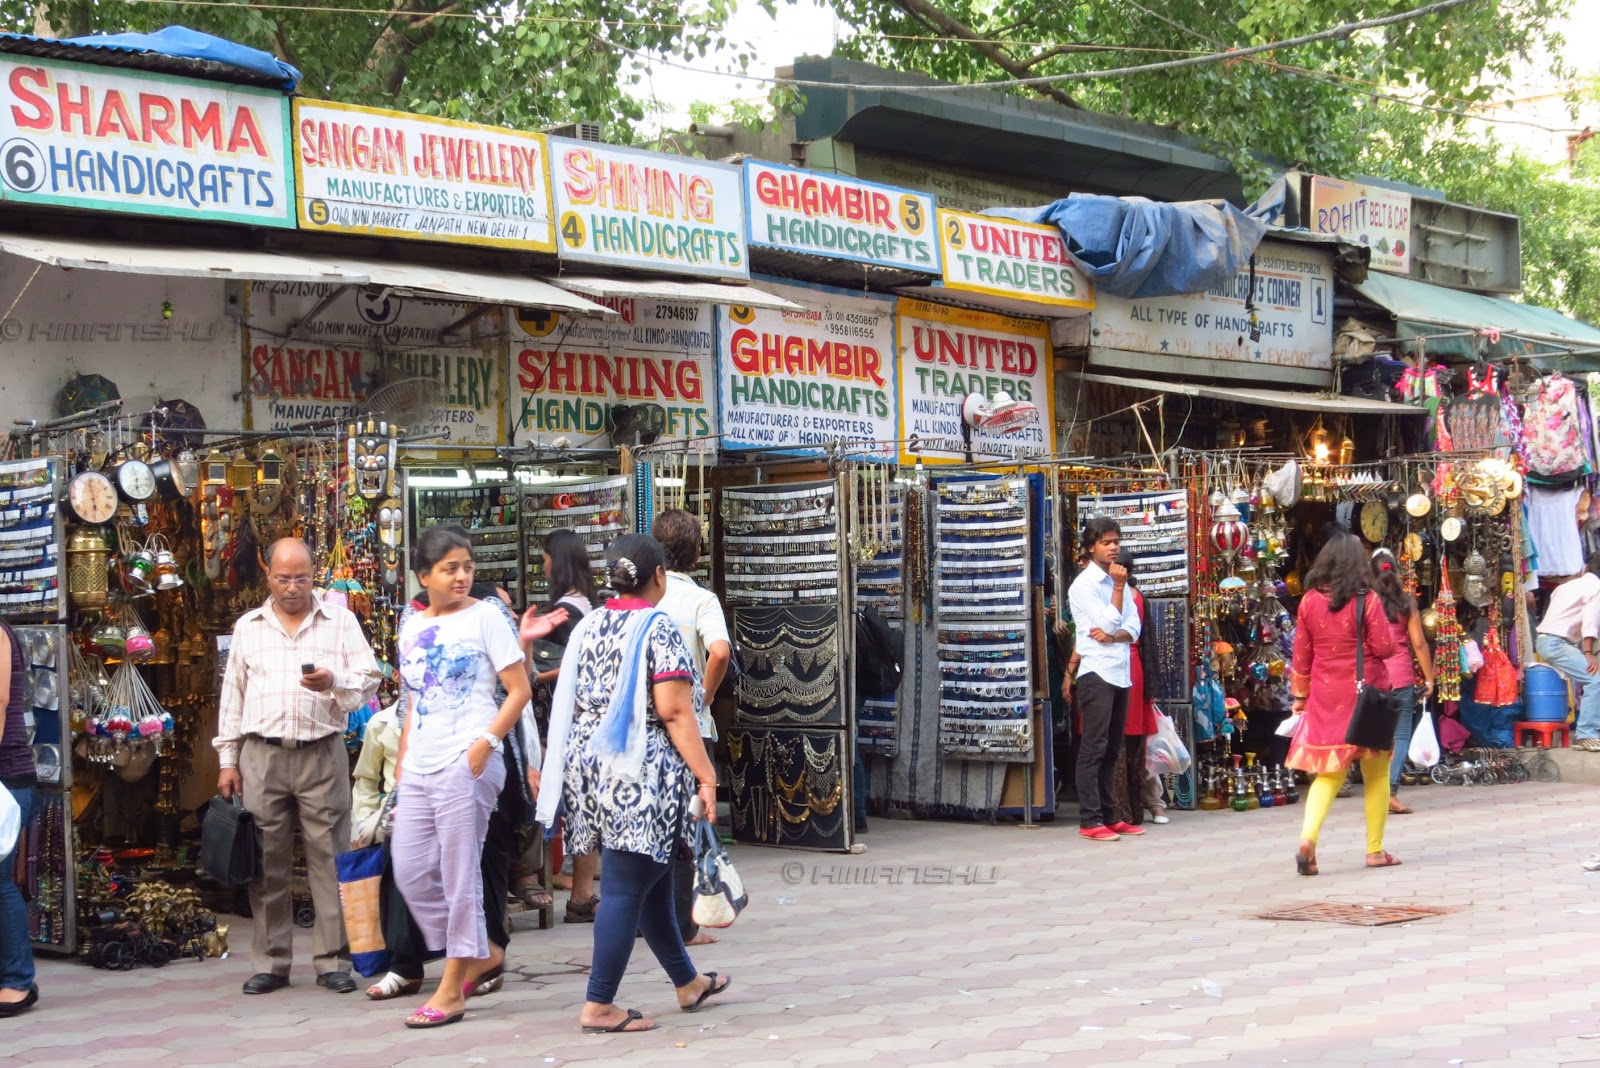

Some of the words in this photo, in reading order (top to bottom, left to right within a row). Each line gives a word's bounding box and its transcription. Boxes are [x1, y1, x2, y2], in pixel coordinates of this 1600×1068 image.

[9, 66, 271, 160] SHARMA
[5, 144, 37, 189] 6
[48, 144, 275, 208] HANDICRAFTS
[301, 118, 406, 175] SANGAM
[413, 132, 537, 196] JEWELLERY
[327, 177, 449, 210] MANUFACTURES
[453, 192, 464, 210] &
[465, 190, 535, 218] EXPORTERS
[563, 148, 714, 224] SHINING
[756, 171, 898, 232] GHAMBIR
[904, 198, 921, 231] 3
[312, 201, 327, 222] 5
[467, 220, 488, 236] NEW
[1317, 199, 1369, 234] ROHIT
[1369, 201, 1387, 228] BELT
[1387, 209, 1393, 229] &
[1395, 206, 1409, 232] CAP
[561, 215, 583, 247] 4
[591, 213, 742, 267] HANDICRAFTS
[766, 213, 931, 263] HANDICRAFTS
[948, 219, 963, 246] 2
[957, 253, 1077, 297] TRADERS
[1208, 273, 1264, 303] ANDICRATS
[1266, 276, 1301, 308] CORNER
[655, 304, 699, 323] 27946197
[1314, 286, 1324, 317] 1
[325, 322, 344, 336] MINI
[632, 326, 644, 344] ALL
[645, 326, 665, 345] KINDS
[1129, 304, 1153, 323] ALL
[1158, 307, 1188, 327] TYPE
[1194, 313, 1210, 328] OF
[1215, 315, 1294, 339] HANDIRAFTS
[730, 328, 887, 390] GHAMBIR
[912, 325, 1039, 377] UNITED
[252, 344, 366, 402] SANGAM
[517, 349, 704, 404] SHINING
[914, 366, 1033, 404] TRADERS
[274, 404, 360, 420] MANUFACTU
[730, 374, 889, 421] HANDICRAFTS
[912, 398, 962, 417] MANUFACTU
[521, 396, 710, 438] HANDIRAFTS
[727, 410, 800, 429] MANUFACTURERS
[803, 416, 811, 429] &
[813, 416, 874, 436] EXPORTERS
[729, 426, 747, 439] ALL
[748, 428, 775, 442] KINDS
[913, 419, 930, 433] ALL
[932, 420, 957, 435] KINDS
